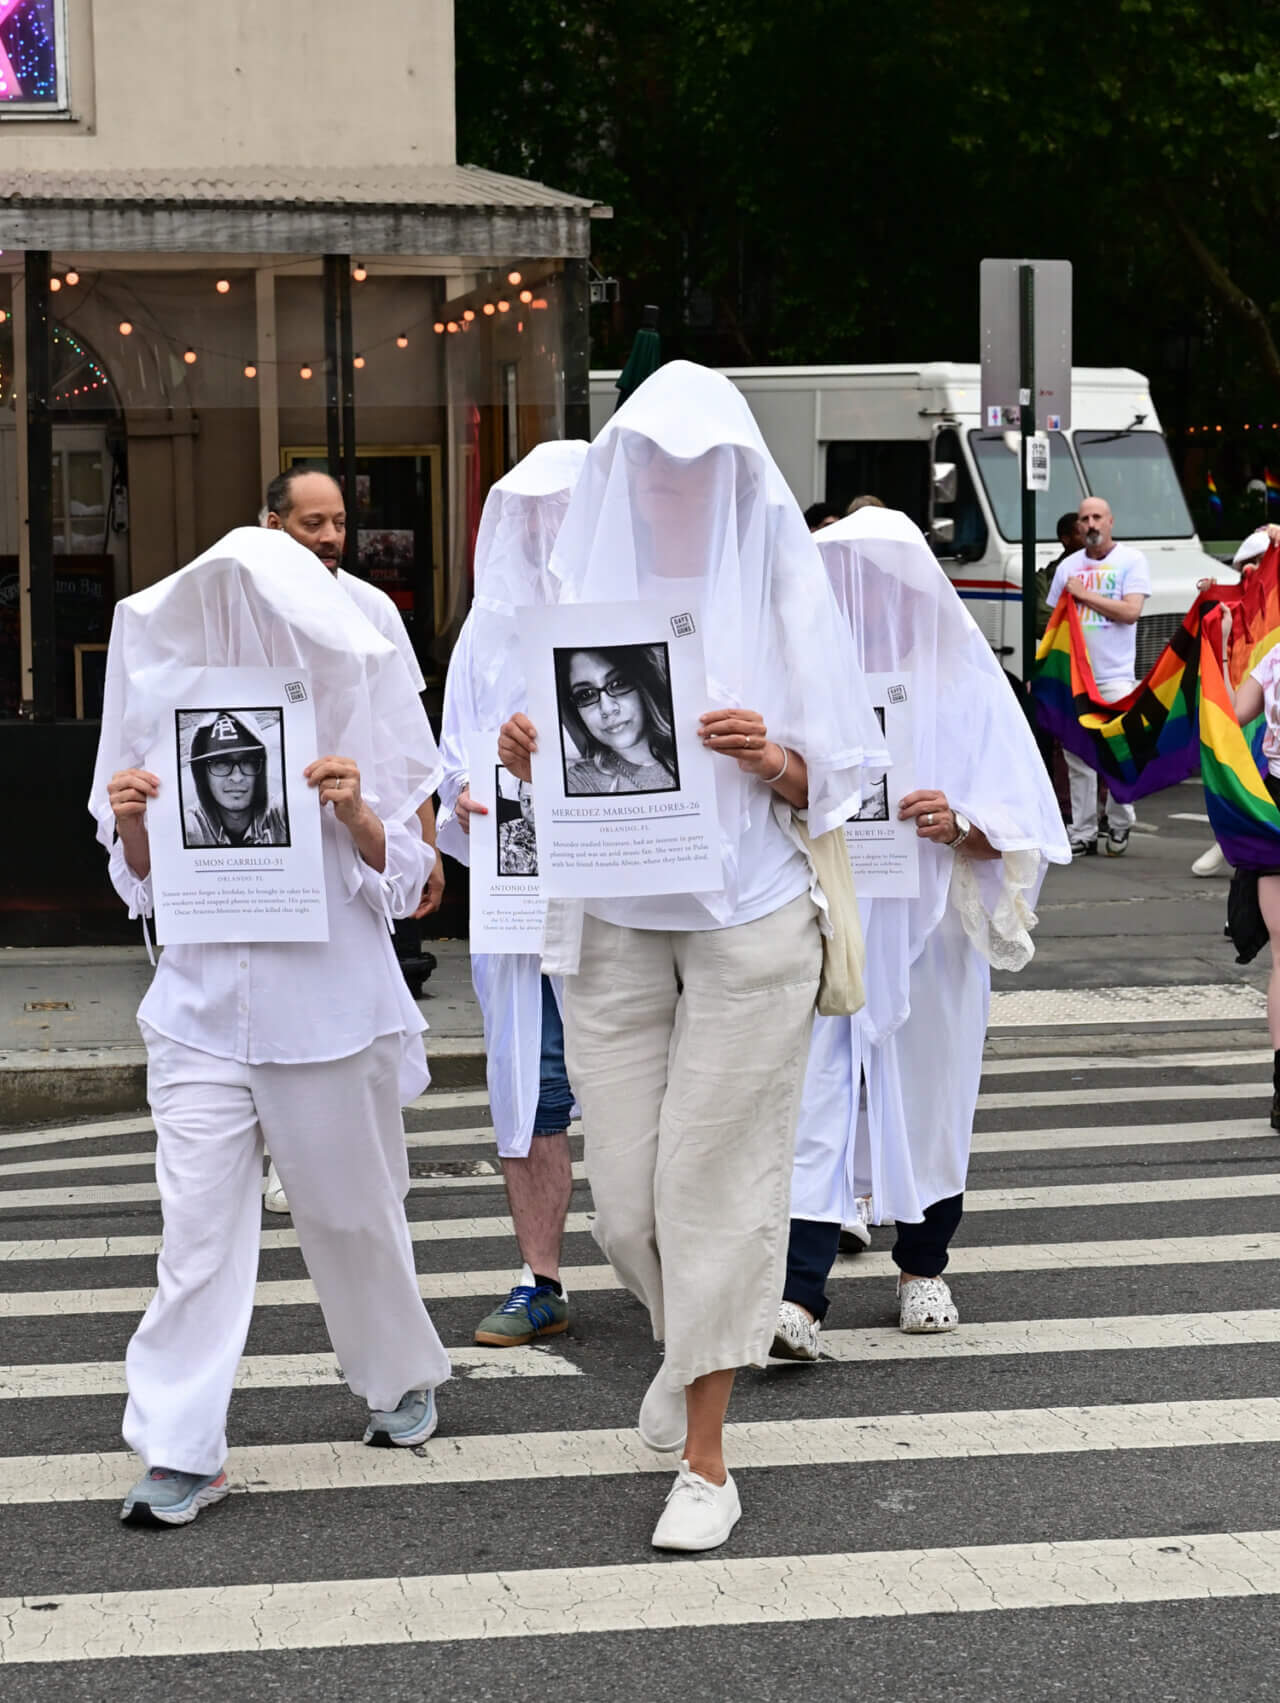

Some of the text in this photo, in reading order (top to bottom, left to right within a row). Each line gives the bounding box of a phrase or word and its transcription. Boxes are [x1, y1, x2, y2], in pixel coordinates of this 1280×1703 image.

[674, 616, 688, 624] GAYS
[552, 808, 600, 817] MERCEDEZ
[603, 806, 645, 816] MARISOL
[194, 858, 224, 866] SIMON
